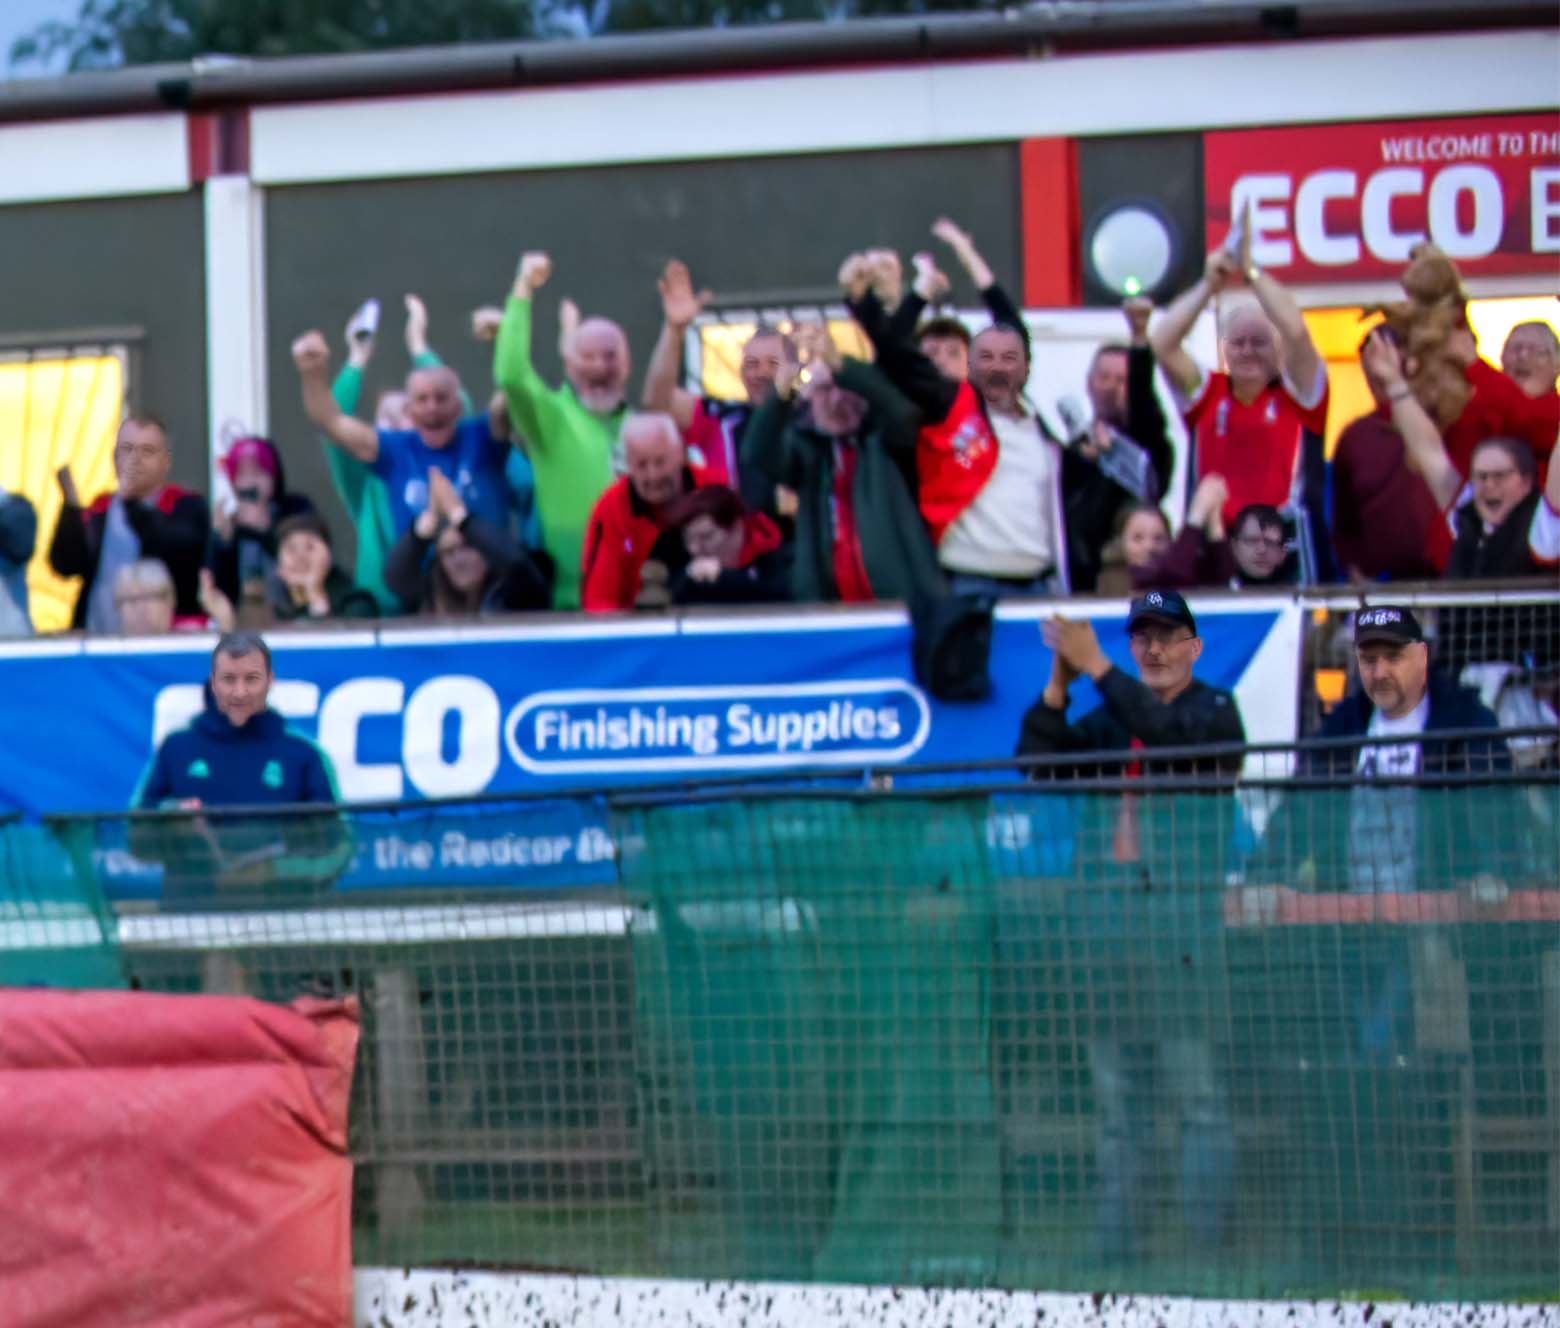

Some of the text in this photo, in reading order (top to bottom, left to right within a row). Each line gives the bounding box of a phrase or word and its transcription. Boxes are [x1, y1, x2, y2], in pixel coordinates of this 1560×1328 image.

[1382, 136, 1491, 161] WELCOME
[1498, 132, 1523, 155] TO
[1231, 164, 1504, 267] ECCO
[153, 674, 901, 803] CO Finishing Supplies
[374, 836, 433, 870] the
[440, 831, 573, 867] Redcar
